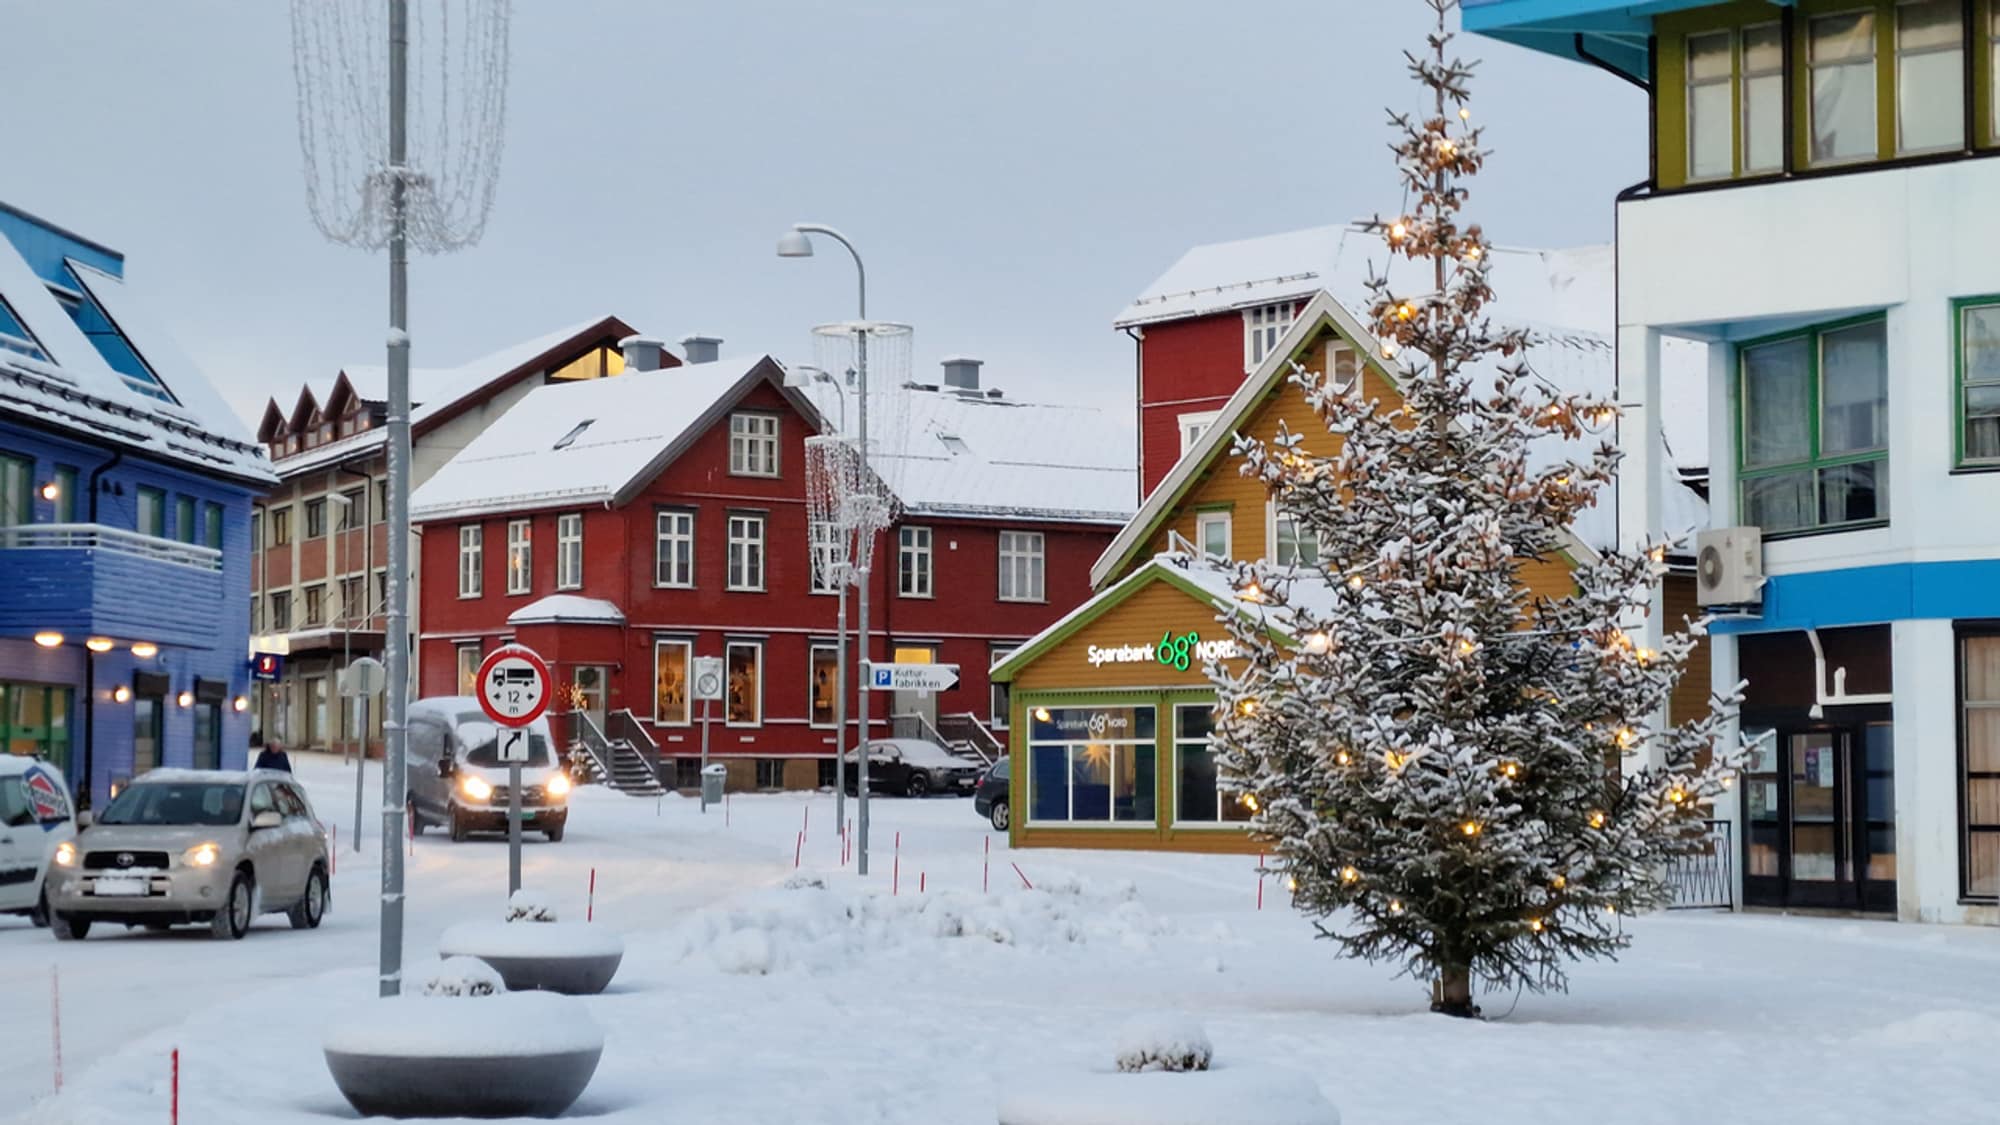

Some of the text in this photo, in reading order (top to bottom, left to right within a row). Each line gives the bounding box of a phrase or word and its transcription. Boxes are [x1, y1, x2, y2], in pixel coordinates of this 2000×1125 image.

[1088, 643, 1155, 668] Sparebank
[879, 671, 889, 684] P
[895, 669, 927, 678] Kultur-
[895, 679, 940, 688] fabrikken
[508, 690, 520, 703] 12
